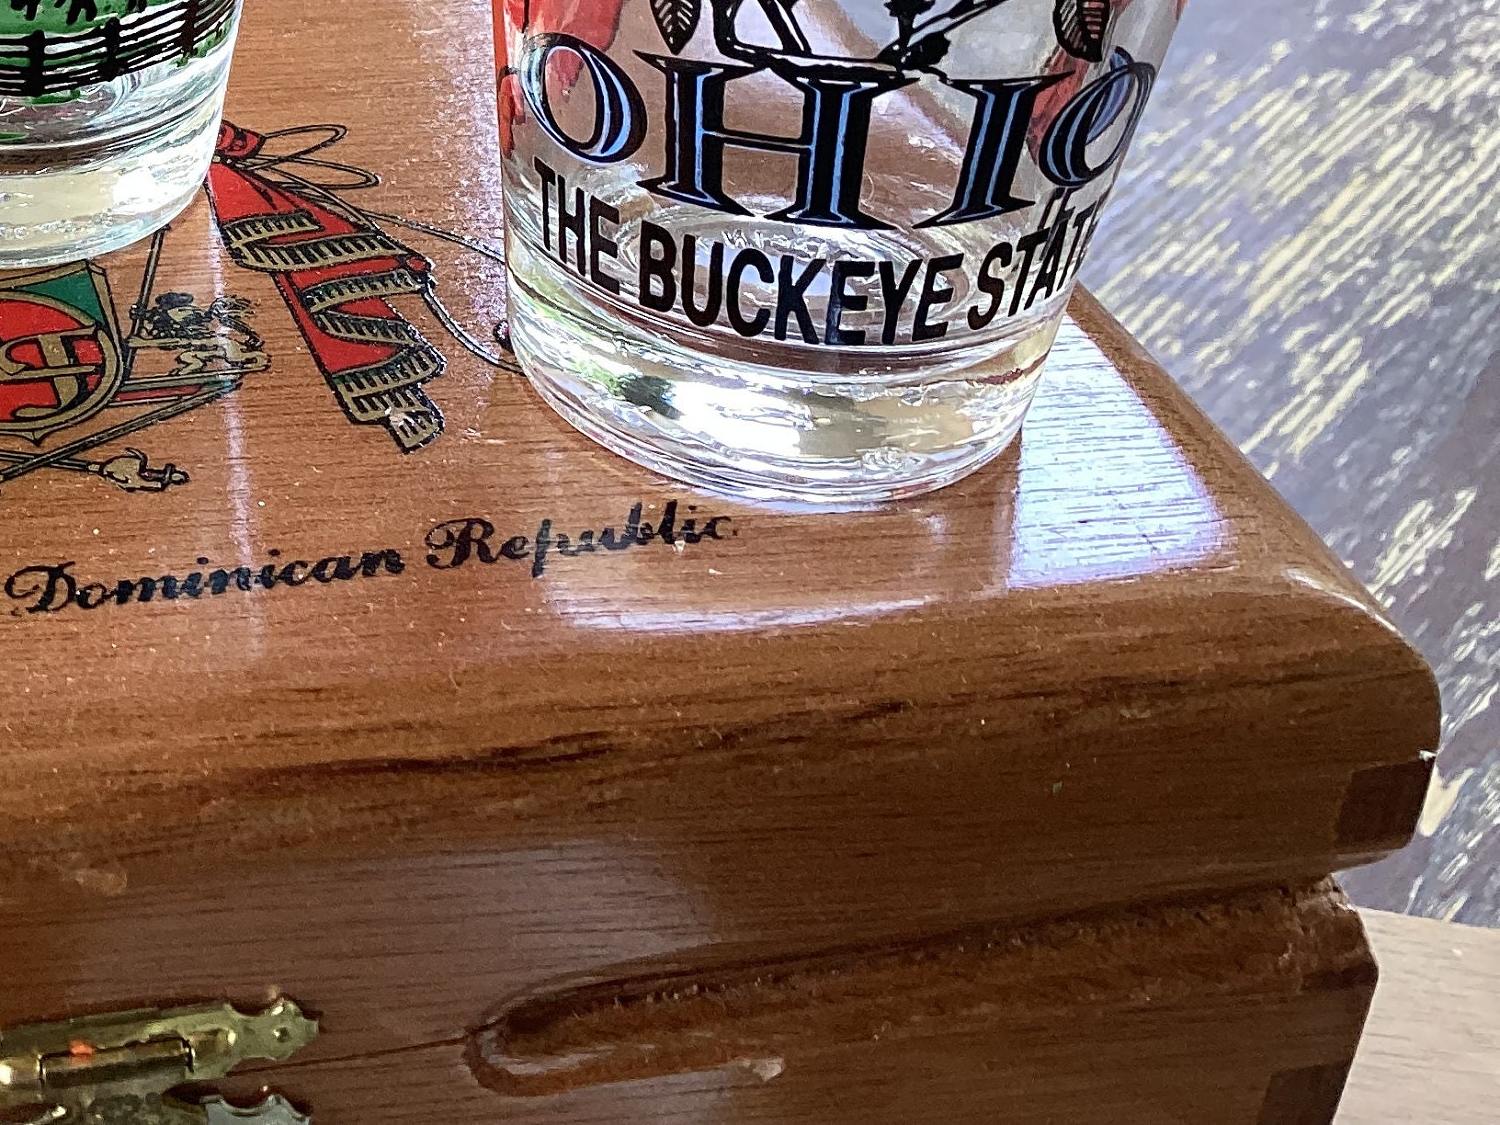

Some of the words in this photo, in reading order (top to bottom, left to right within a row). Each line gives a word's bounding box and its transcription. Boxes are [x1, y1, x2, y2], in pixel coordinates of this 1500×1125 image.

[519, 31, 1159, 230] OHIO
[533, 157, 621, 290] THE
[638, 219, 965, 346] BUCKEYE
[4, 547, 405, 616] Dominican
[424, 498, 738, 578] Republic
